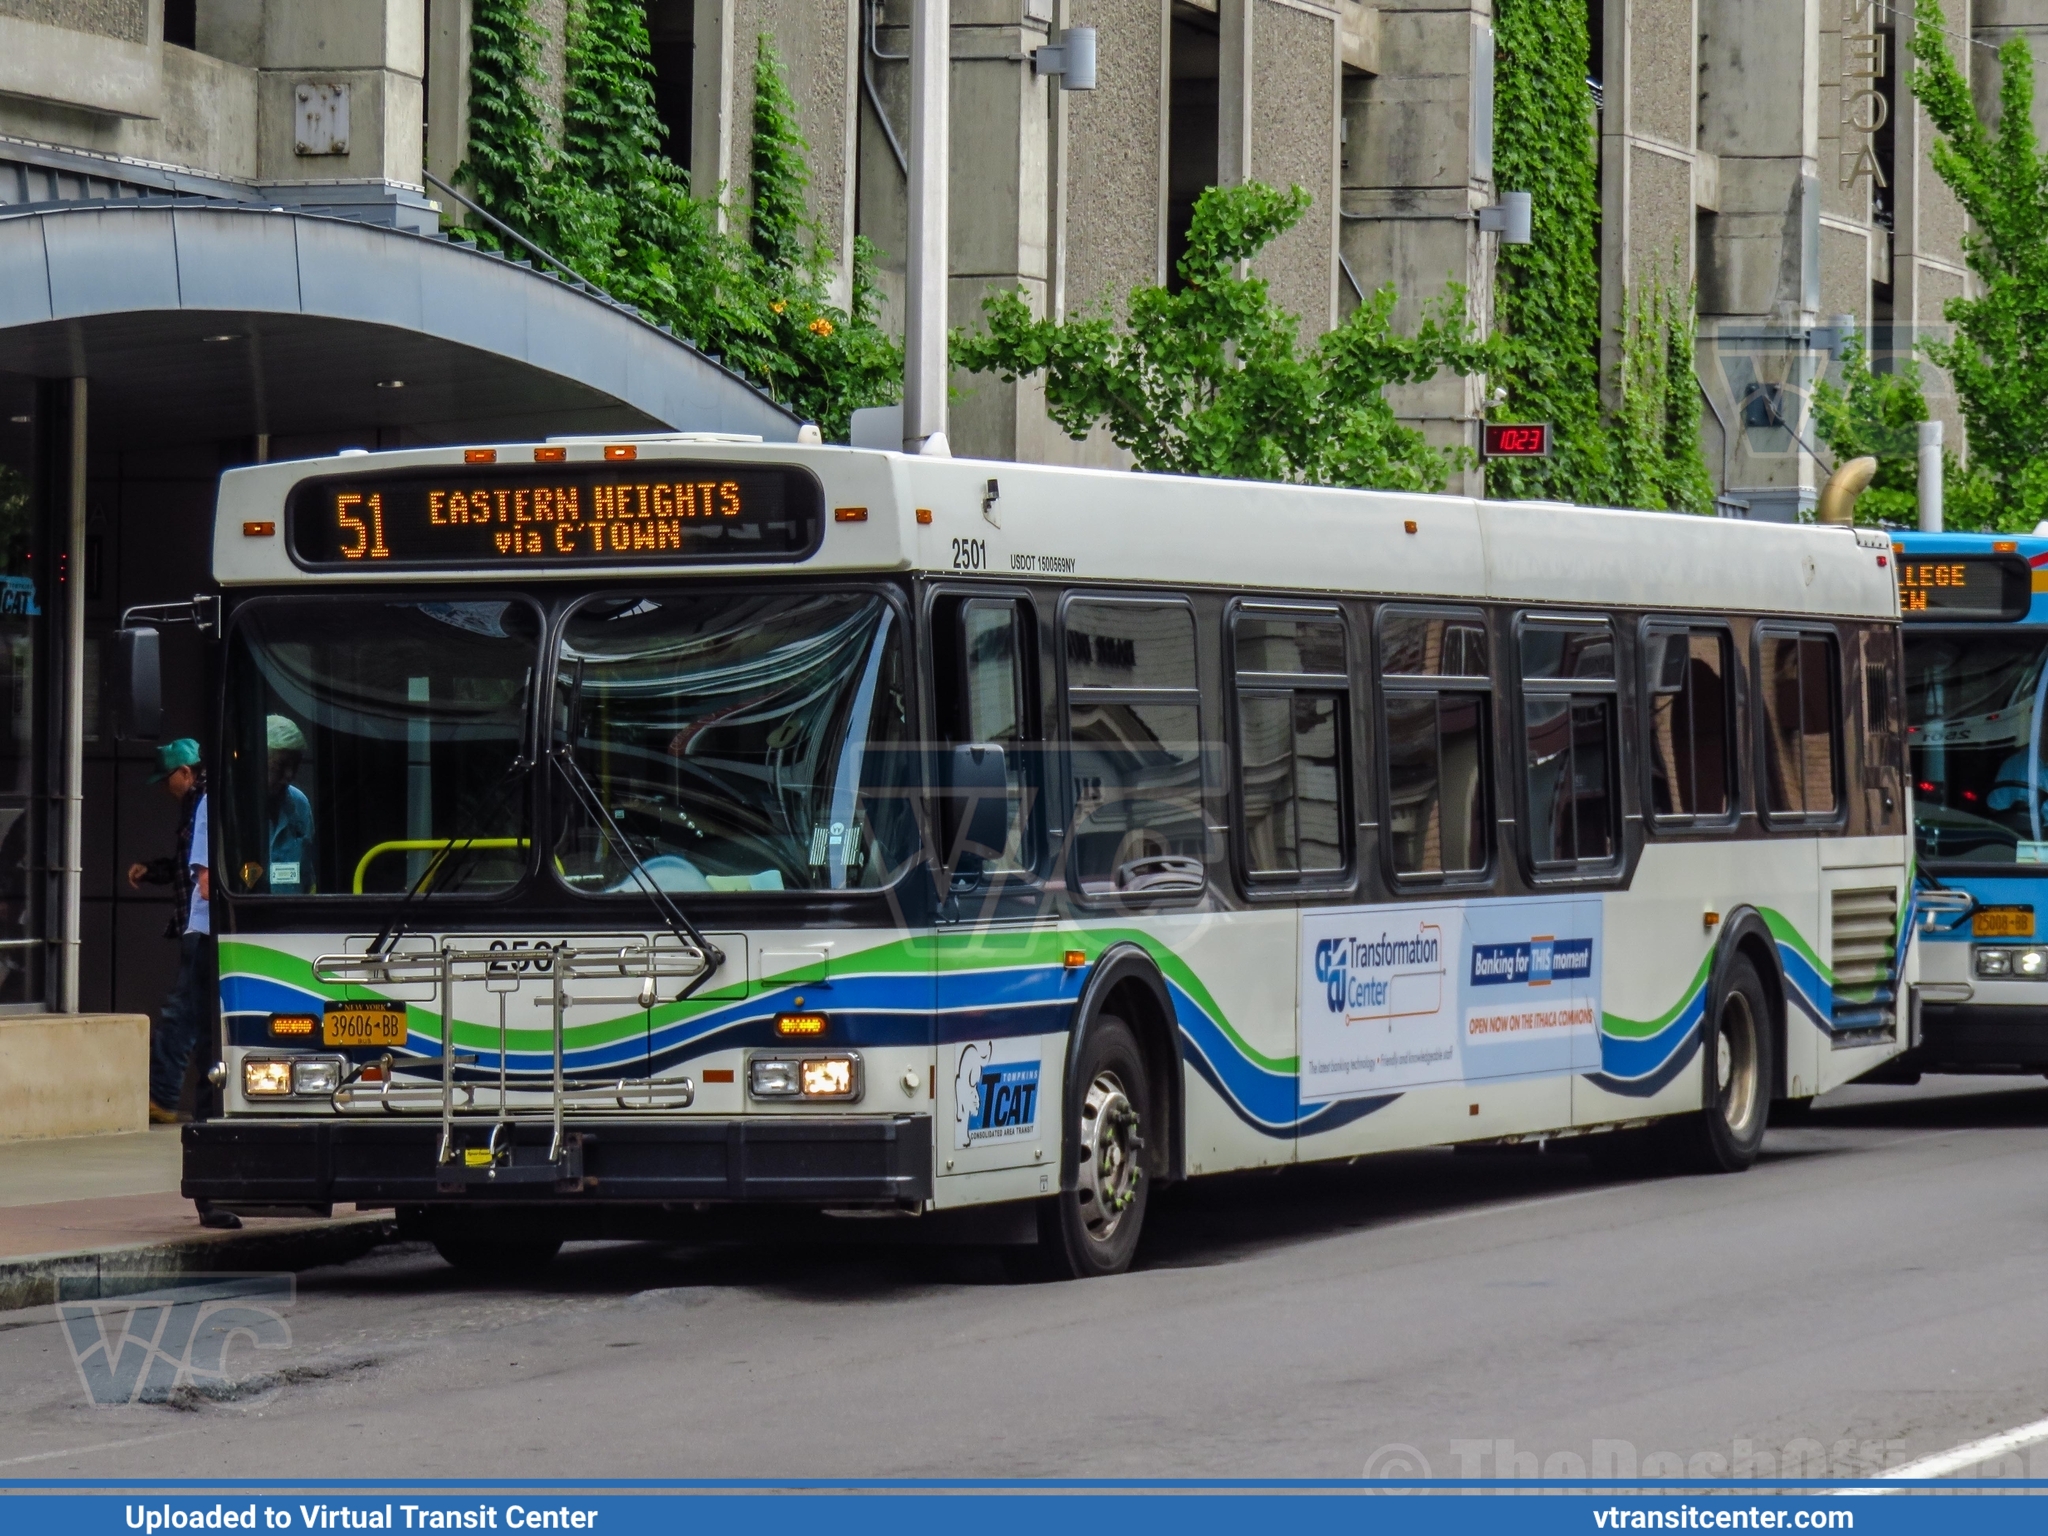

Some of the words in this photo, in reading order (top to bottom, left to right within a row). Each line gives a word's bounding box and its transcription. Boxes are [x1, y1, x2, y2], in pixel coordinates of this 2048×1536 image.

[429, 488, 579, 525] EASTERN
[594, 481, 741, 520] HEIGHTS
[336, 493, 390, 559] 51
[494, 525, 543, 554] via
[952, 538, 987, 570] 2501
[1010, 554, 1036, 570] USDOT
[1037, 556, 1076, 573] 1500569NY
[1896, 565, 1966, 586] LEGE
[0, 582, 32, 614] CAT
[489, 940, 567, 971] 250
[1349, 932, 1438, 968] Transformation
[1475, 949, 1514, 980] Banking
[1515, 948, 1529, 973] for
[1531, 948, 1551, 971] THIS
[1553, 948, 1589, 970] moment
[1348, 976, 1388, 1008] Center
[1469, 1017, 1488, 1034] OPEN
[1489, 1015, 1508, 1033] NOW
[1509, 1014, 1520, 1031] ON
[1521, 1013, 1533, 1030] THE
[1534, 1011, 1557, 1028] ITHACA
[1558, 1008, 1593, 1026] COMMONS
[1003, 1070, 1038, 1083] TOMPKINS
[982, 1073, 1036, 1128] TCAT
[971, 1129, 1003, 1140] CONSOLIDATED
[1004, 1127, 1015, 1136] AREA
[1016, 1125, 1034, 1134] TRANSIT
